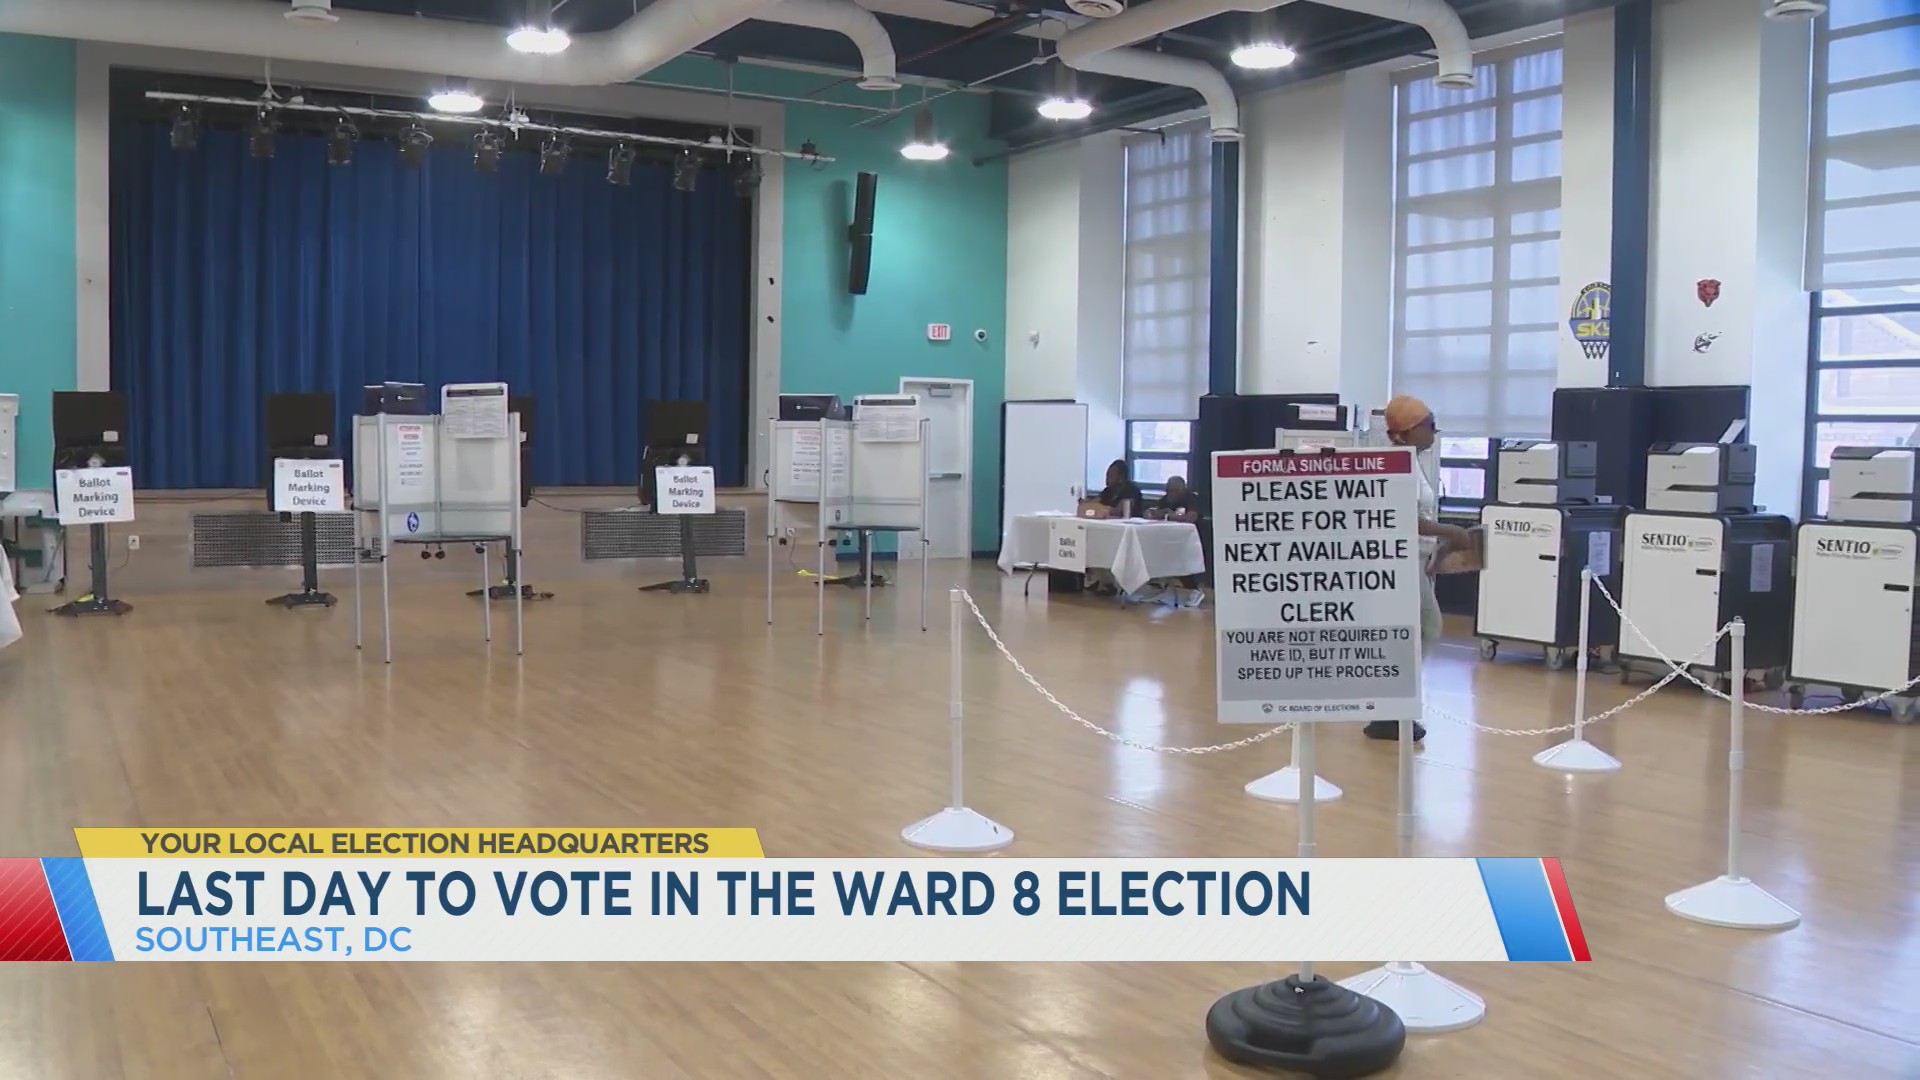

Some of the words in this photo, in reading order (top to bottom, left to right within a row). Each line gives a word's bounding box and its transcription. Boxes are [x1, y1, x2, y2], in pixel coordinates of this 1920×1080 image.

[932, 325, 948, 338] EXIT
[1242, 460, 1284, 474] FORM
[1285, 459, 1297, 473] A
[1300, 458, 1351, 472] SINGLE
[1354, 457, 1385, 470] LINE
[294, 470, 323, 478] Ballot
[79, 478, 111, 487] Ballot
[288, 482, 330, 493] Marking
[669, 488, 704, 497] Marking
[1242, 480, 1327, 501] PLEASE
[1335, 479, 1388, 499] WAIT
[73, 493, 118, 503] Marking
[292, 496, 326, 505] Device
[672, 500, 700, 508] Device
[78, 507, 115, 517] Device
[1235, 512, 1294, 531] HERE
[1302, 510, 1347, 530] FOR
[1353, 509, 1396, 529] THE
[1494, 519, 1531, 532] SENTIO
[1642, 533, 1686, 546] SENTIO
[1817, 538, 1870, 553] SENTIO
[1225, 542, 1281, 562] NEXT
[1288, 539, 1408, 561] AVAILABLE
[1233, 570, 1395, 593] REGISTRATION
[1281, 602, 1355, 623] CLERK
[1227, 632, 1254, 644] YOU
[1258, 631, 1285, 644] ARE
[1289, 630, 1315, 644] NOT
[1320, 629, 1388, 642] REQUIRED
[1392, 628, 1409, 640] TO
[1250, 649, 1286, 662] HAVE
[1288, 649, 1305, 663] ID,
[1309, 648, 1335, 660] BUT
[1339, 648, 1351, 660] IT
[1354, 648, 1386, 660] WILL
[1238, 667, 1281, 680] SPEED
[1285, 667, 1303, 679] UP
[1307, 667, 1334, 679] THE
[1336, 665, 1399, 678] PROCESS
